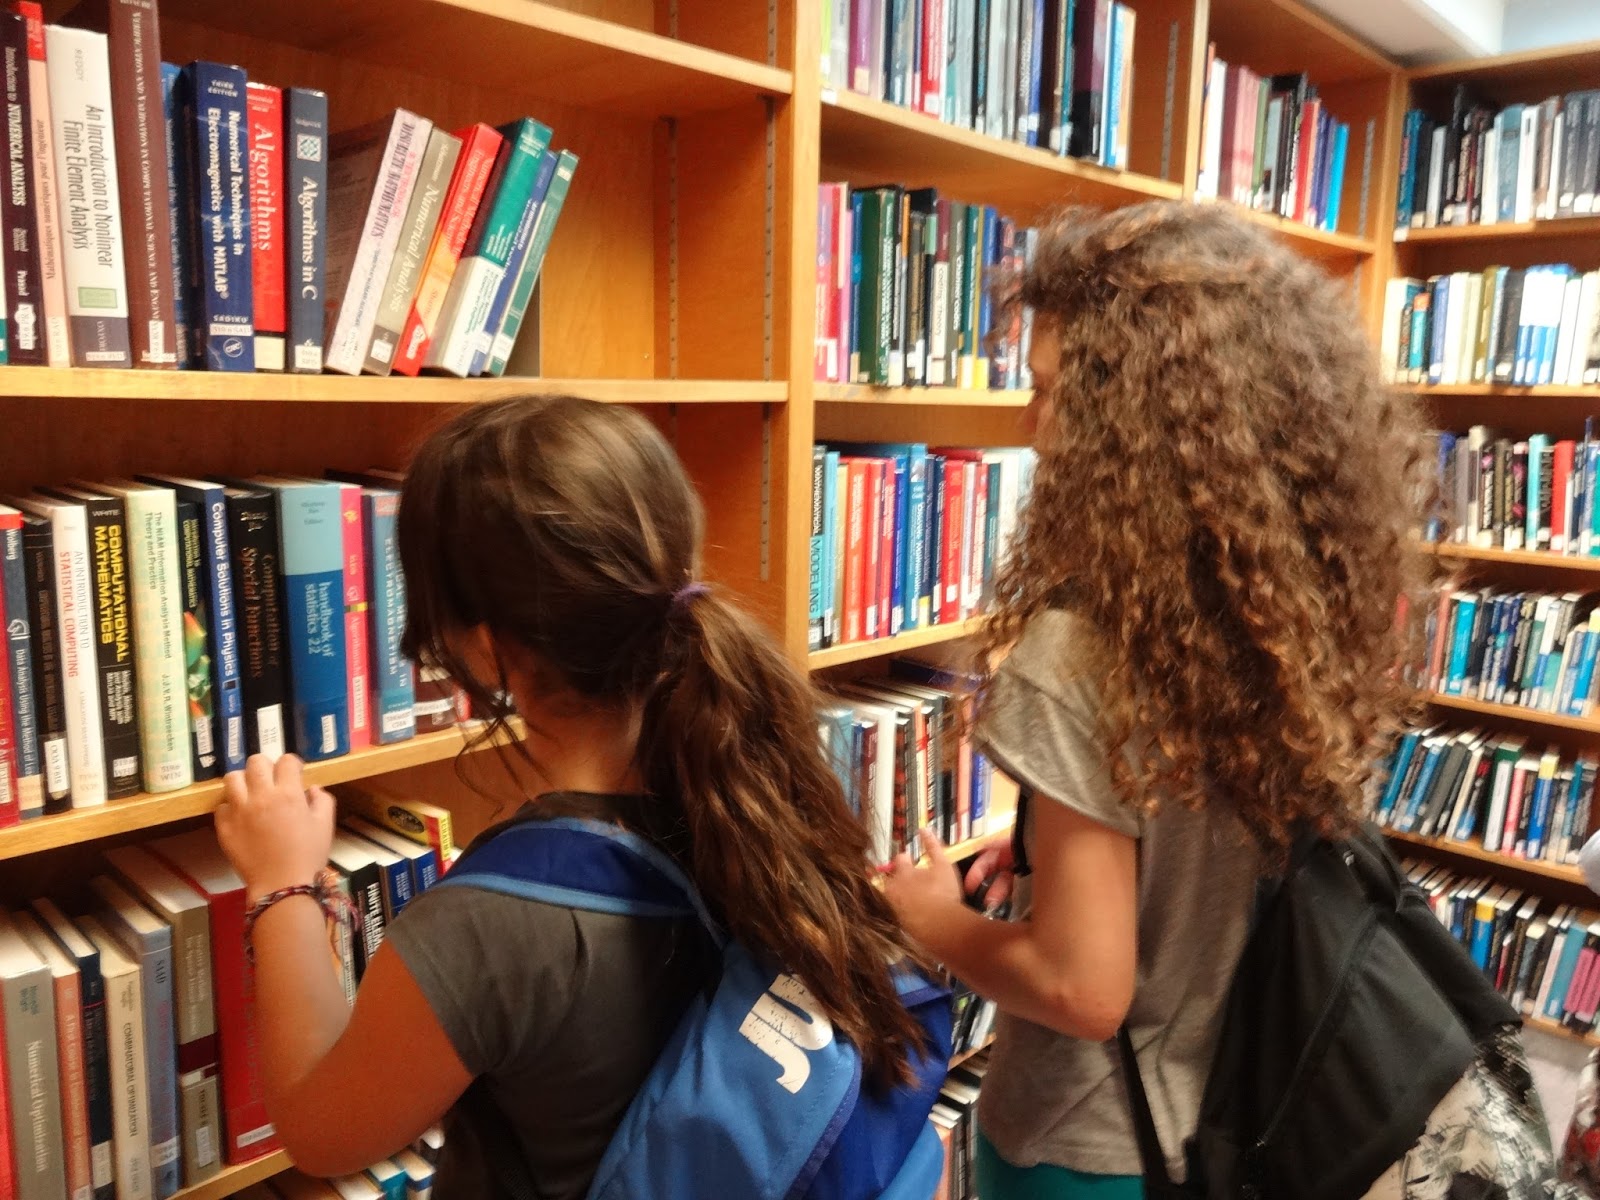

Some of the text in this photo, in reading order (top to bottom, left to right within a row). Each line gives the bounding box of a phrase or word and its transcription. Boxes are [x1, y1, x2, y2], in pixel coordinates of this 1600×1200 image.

[86, 105, 105, 120] An
[208, 87, 238, 97] EDITION
[211, 80, 234, 89] THIRD
[7, 103, 25, 159] NUMERICAL
[87, 124, 111, 197] Introduction
[207, 107, 224, 211] Electromagnetics
[10, 161, 27, 206] ANALYSIS
[63, 120, 93, 249] Finite Element Analysis
[93, 200, 106, 210] to
[228, 110, 246, 256] Numerical Techniques in
[250, 123, 277, 250] Algorithms
[371, 122, 416, 241] DISCRETE MATHEMATICS
[95, 214, 115, 268] Nonlinear
[212, 215, 225, 242] with
[298, 176, 319, 300] Algorithms in C
[389, 184, 441, 313] Numerical Analysis
[17, 270, 29, 296] Prasad
[213, 314, 249, 323] SADIKU
[935, 304, 944, 337] Theory
[6, 528, 19, 560] Wolberg
[92, 509, 120, 517] WHITE
[191, 519, 200, 558] Introduction
[809, 465, 824, 614] MATHEMATICAL MODELING
[145, 512, 158, 590] Theory and Practice
[183, 519, 197, 608] COMPUTATIONAL MATHEMATICS
[241, 547, 261, 600] Special
[60, 551, 79, 677] STATISTICAL COMPUTING
[74, 551, 90, 649] AN INTRODUCTION TO
[94, 525, 115, 644] MATHEMATICS
[108, 525, 130, 662] COMPUTATIONAL
[154, 511, 172, 659] The NIAM Information Analysis Method
[209, 502, 237, 676] Computer Solutions in Physics
[262, 554, 280, 651] Computation
[385, 538, 397, 675] ELECTROMAGNETISM
[245, 605, 262, 678] Functions
[305, 583, 321, 654] statistics 22
[319, 580, 336, 657] handbook of
[15, 648, 35, 762] Data Analysis Using the Method of
[108, 695, 117, 707] and
[114, 671, 125, 725] and Analysis with
[399, 674, 407, 687] IN
[164, 705, 174, 751] Wintraecken
[441, 818, 449, 858] SCHAUM'S
[363, 913, 374, 932] WITH
[366, 882, 381, 916] FINITE
[123, 1022, 135, 1084] COMBINATORIAL
[26, 1039, 50, 1173] Numerical Optimization
[126, 1084, 138, 1137] OPTIMIZATION
